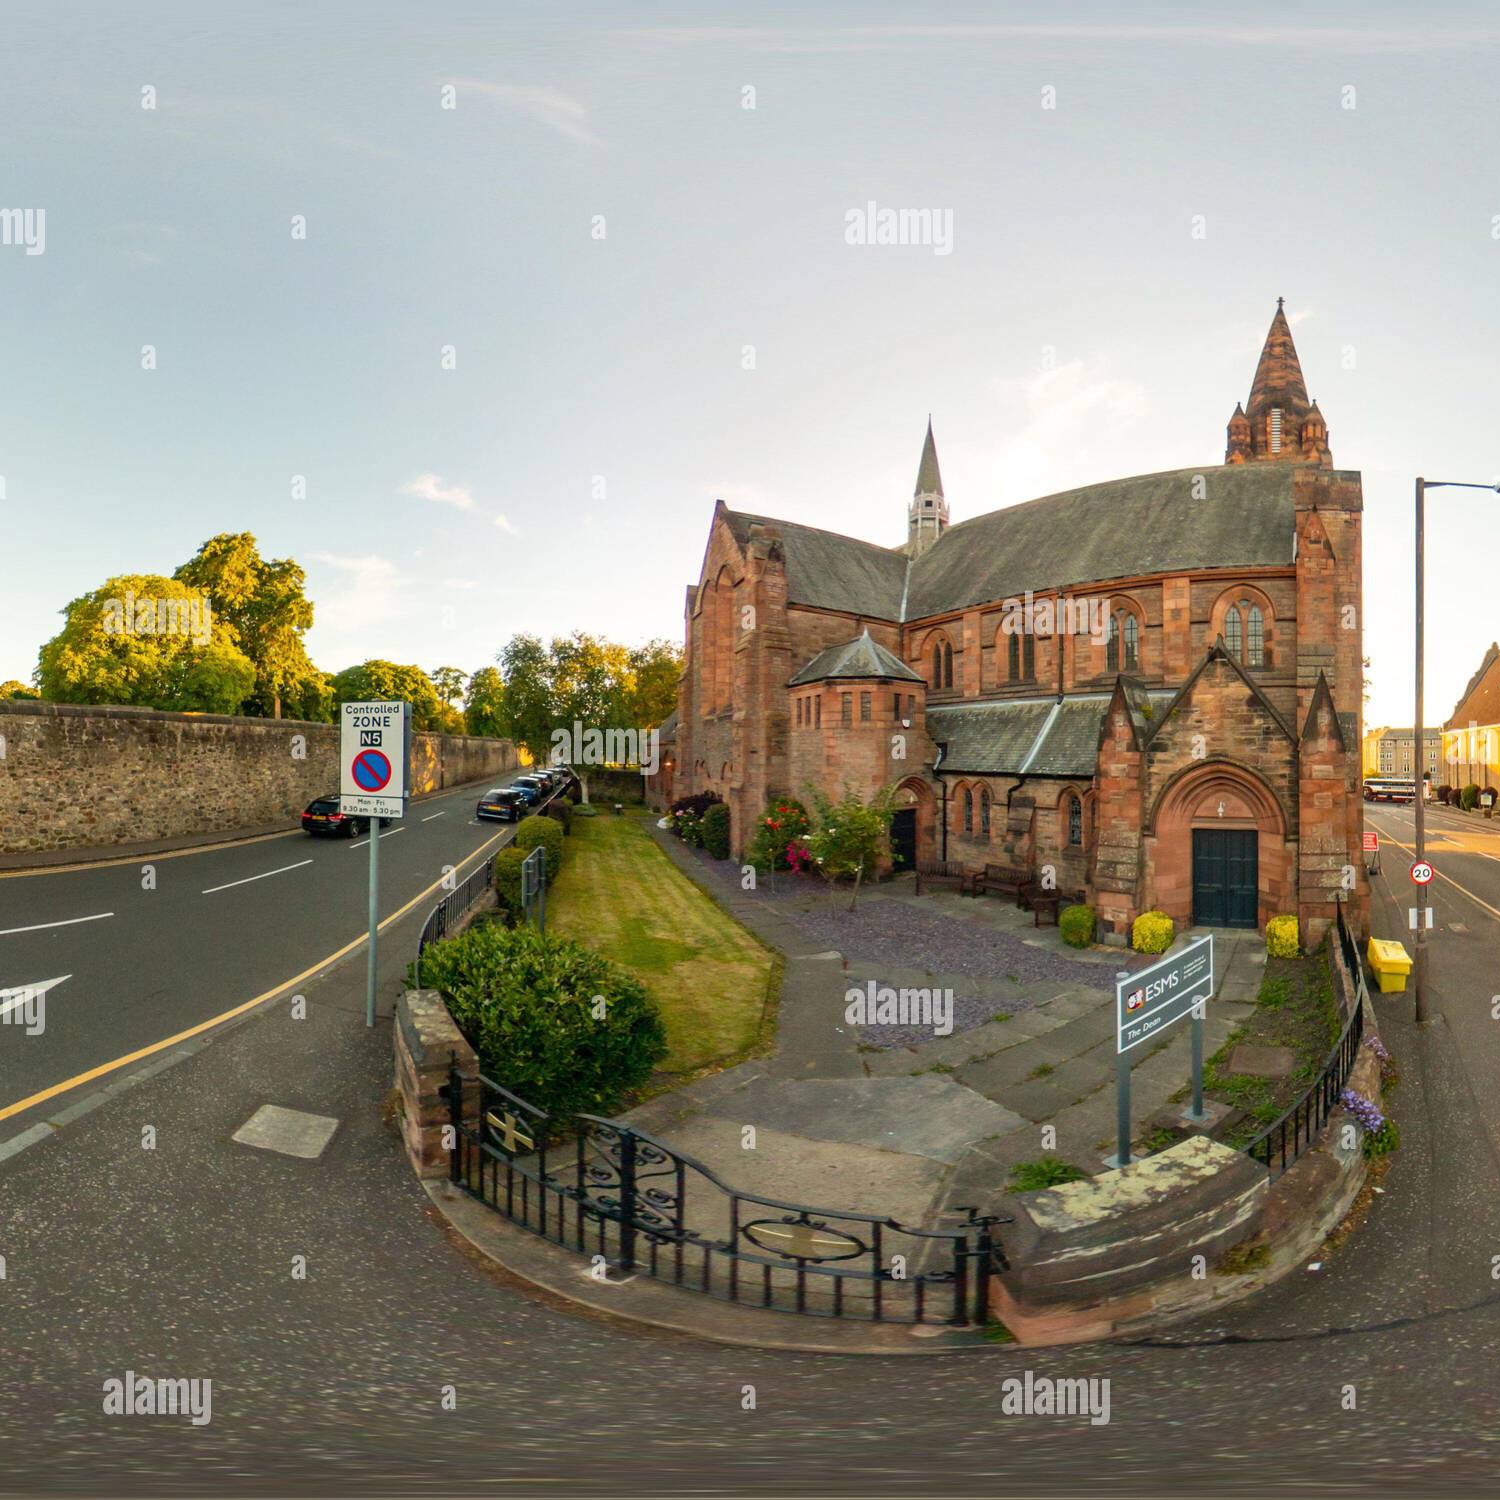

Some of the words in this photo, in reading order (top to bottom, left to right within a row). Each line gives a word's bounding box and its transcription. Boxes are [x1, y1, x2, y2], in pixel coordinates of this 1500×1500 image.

[345, 705, 400, 714] Controlled
[353, 716, 391, 727] ZONE
[361, 732, 381, 745] N5
[1415, 868, 1430, 878] 20
[1145, 970, 1179, 1002] ESMS
[1128, 1029, 1141, 1040] The
[1143, 1017, 1161, 1031] Dean
